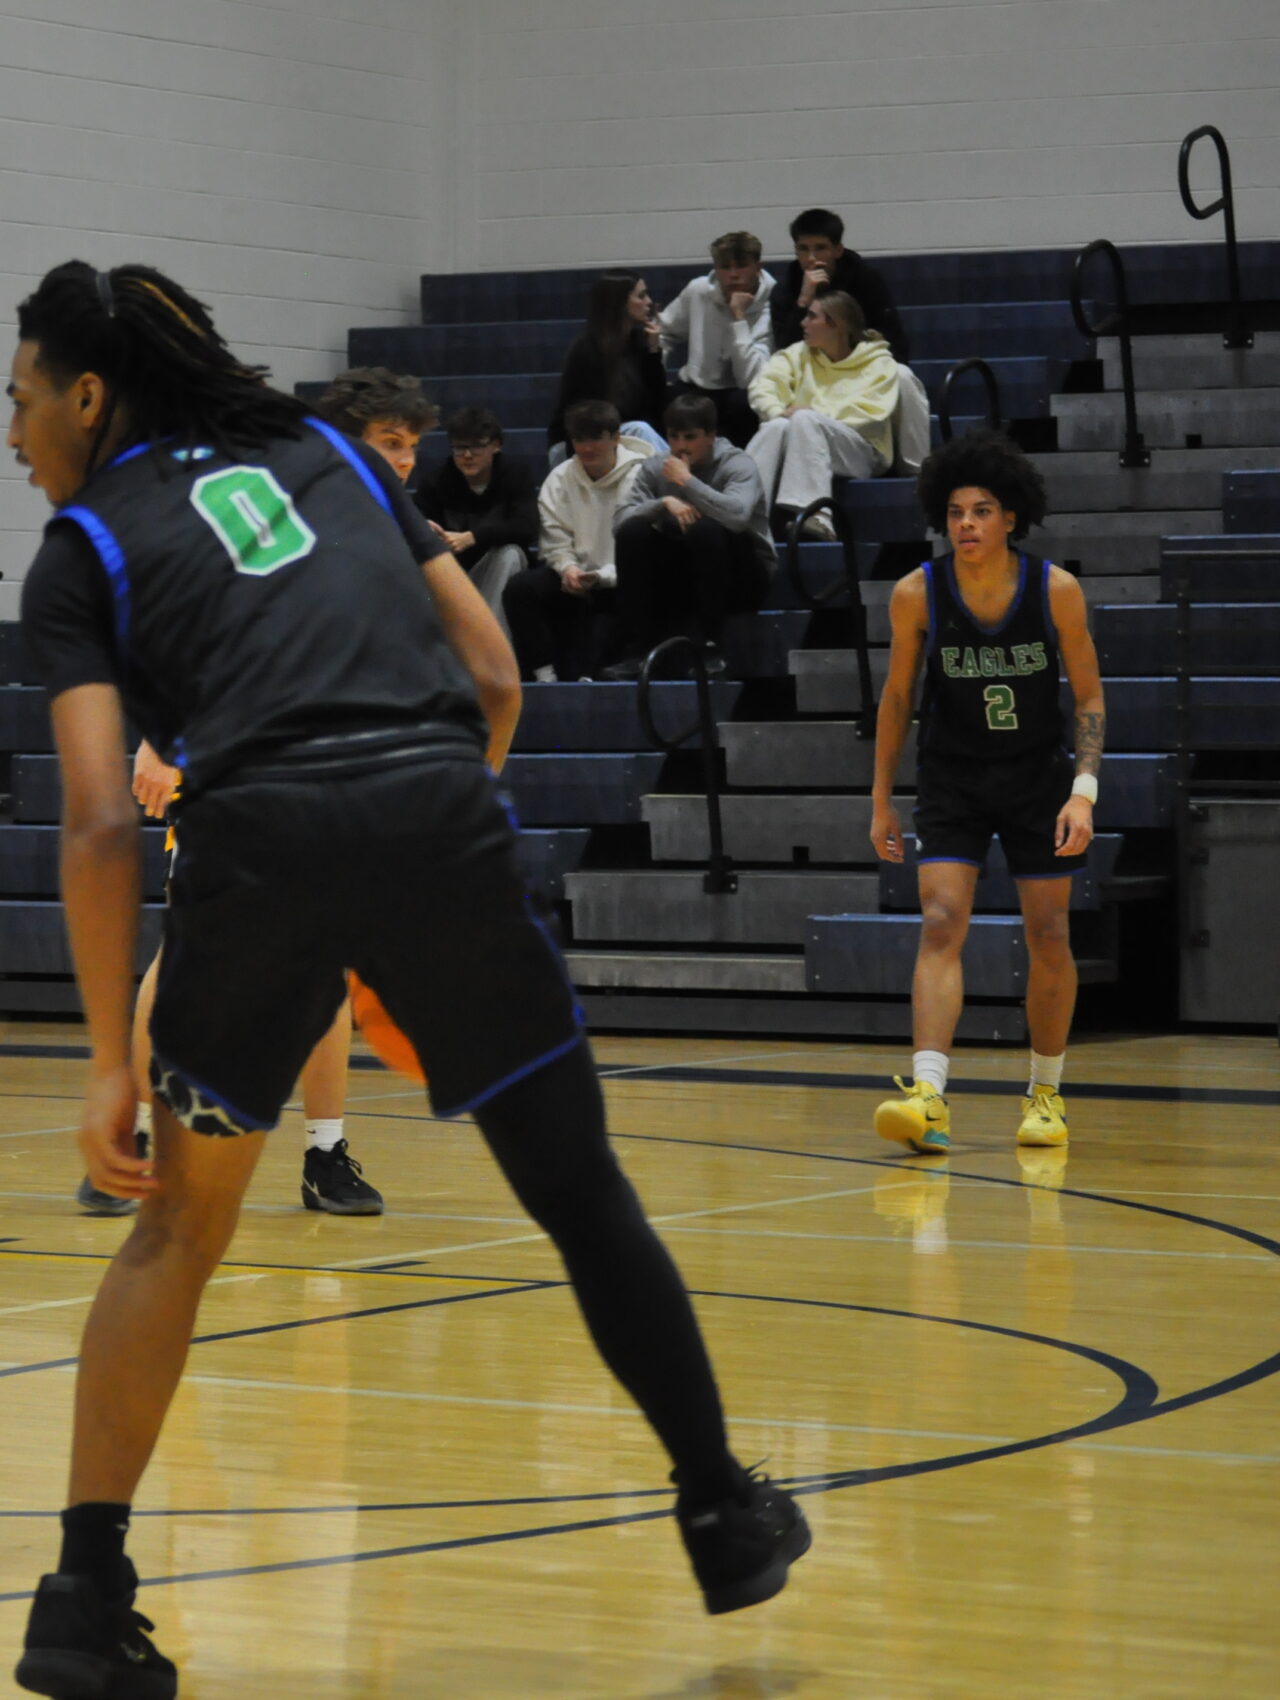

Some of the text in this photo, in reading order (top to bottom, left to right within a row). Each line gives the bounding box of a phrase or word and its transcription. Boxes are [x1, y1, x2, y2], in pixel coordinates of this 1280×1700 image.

[189, 465, 316, 576] 0
[941, 642, 1048, 678] EAGLES
[983, 685, 1018, 730] 2
